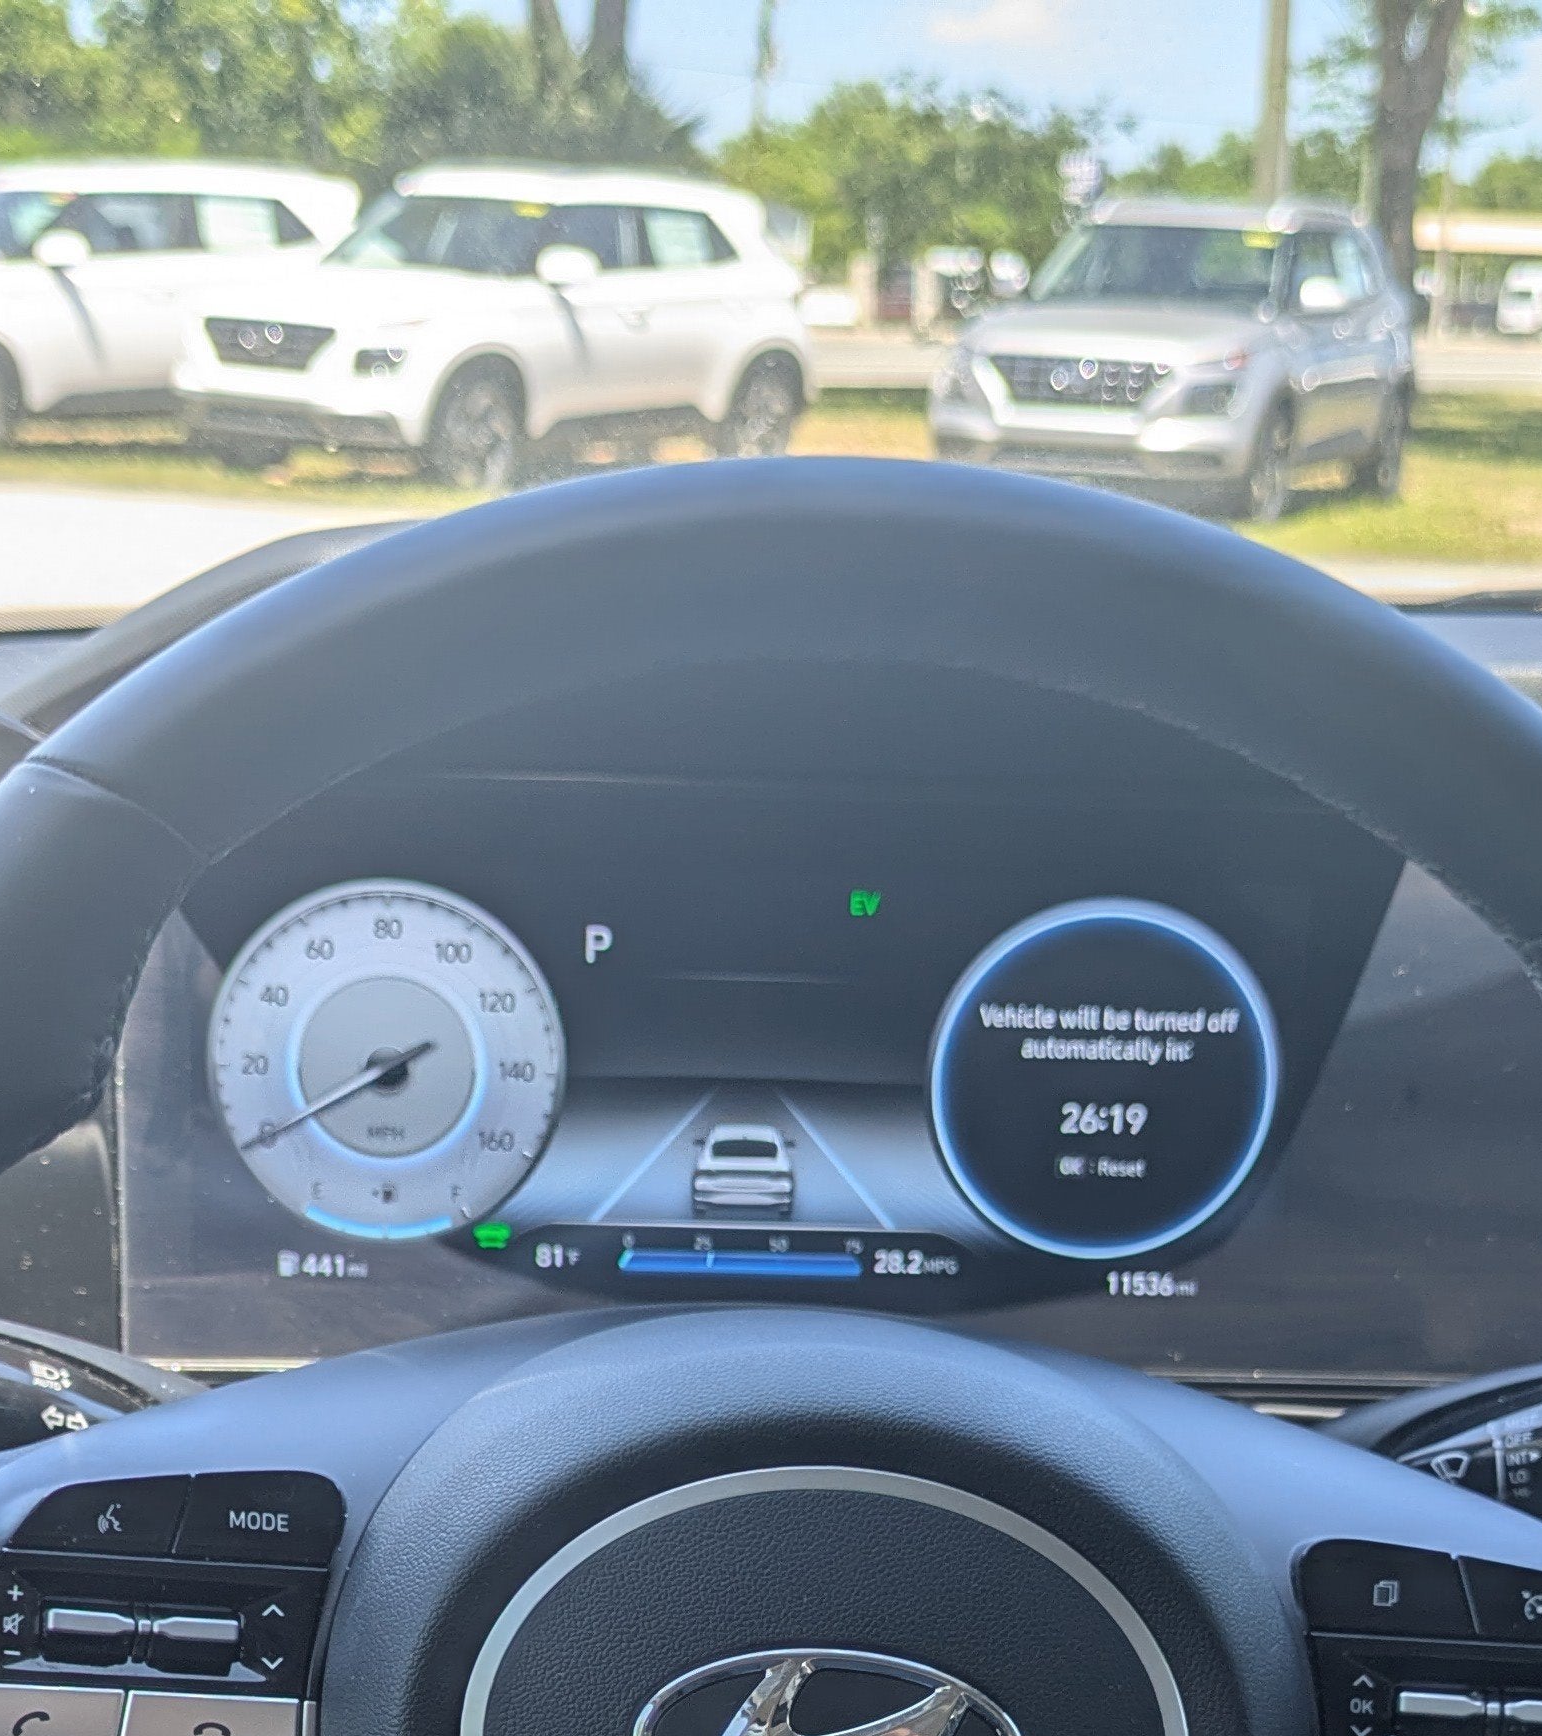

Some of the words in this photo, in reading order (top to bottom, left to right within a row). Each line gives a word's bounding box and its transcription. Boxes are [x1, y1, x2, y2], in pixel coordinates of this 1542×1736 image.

[850, 888, 880, 916] EV
[374, 919, 402, 939] 80
[305, 940, 334, 960] 60
[435, 943, 472, 964] 100
[585, 924, 612, 963] P
[261, 987, 289, 1008] 40
[479, 992, 516, 1013] 120
[980, 1003, 1057, 1031] Vehicle
[1059, 1004, 1100, 1031] will
[1104, 1006, 1130, 1031] be
[1135, 1007, 1204, 1033] turned
[1207, 1008, 1239, 1033] off
[1021, 1036, 1161, 1065] automatically
[242, 1055, 268, 1075] 20
[499, 1062, 535, 1083] 140
[1060, 1102, 1148, 1135] 26:19
[479, 1132, 514, 1152] 160
[1098, 1158, 1146, 1179] Reset
[302, 1252, 345, 1278] 441
[873, 1249, 923, 1276] 28.2
[1107, 1271, 1175, 1298] 11536
[229, 1510, 289, 1533] MODE
[1350, 1699, 1374, 1716] OK
